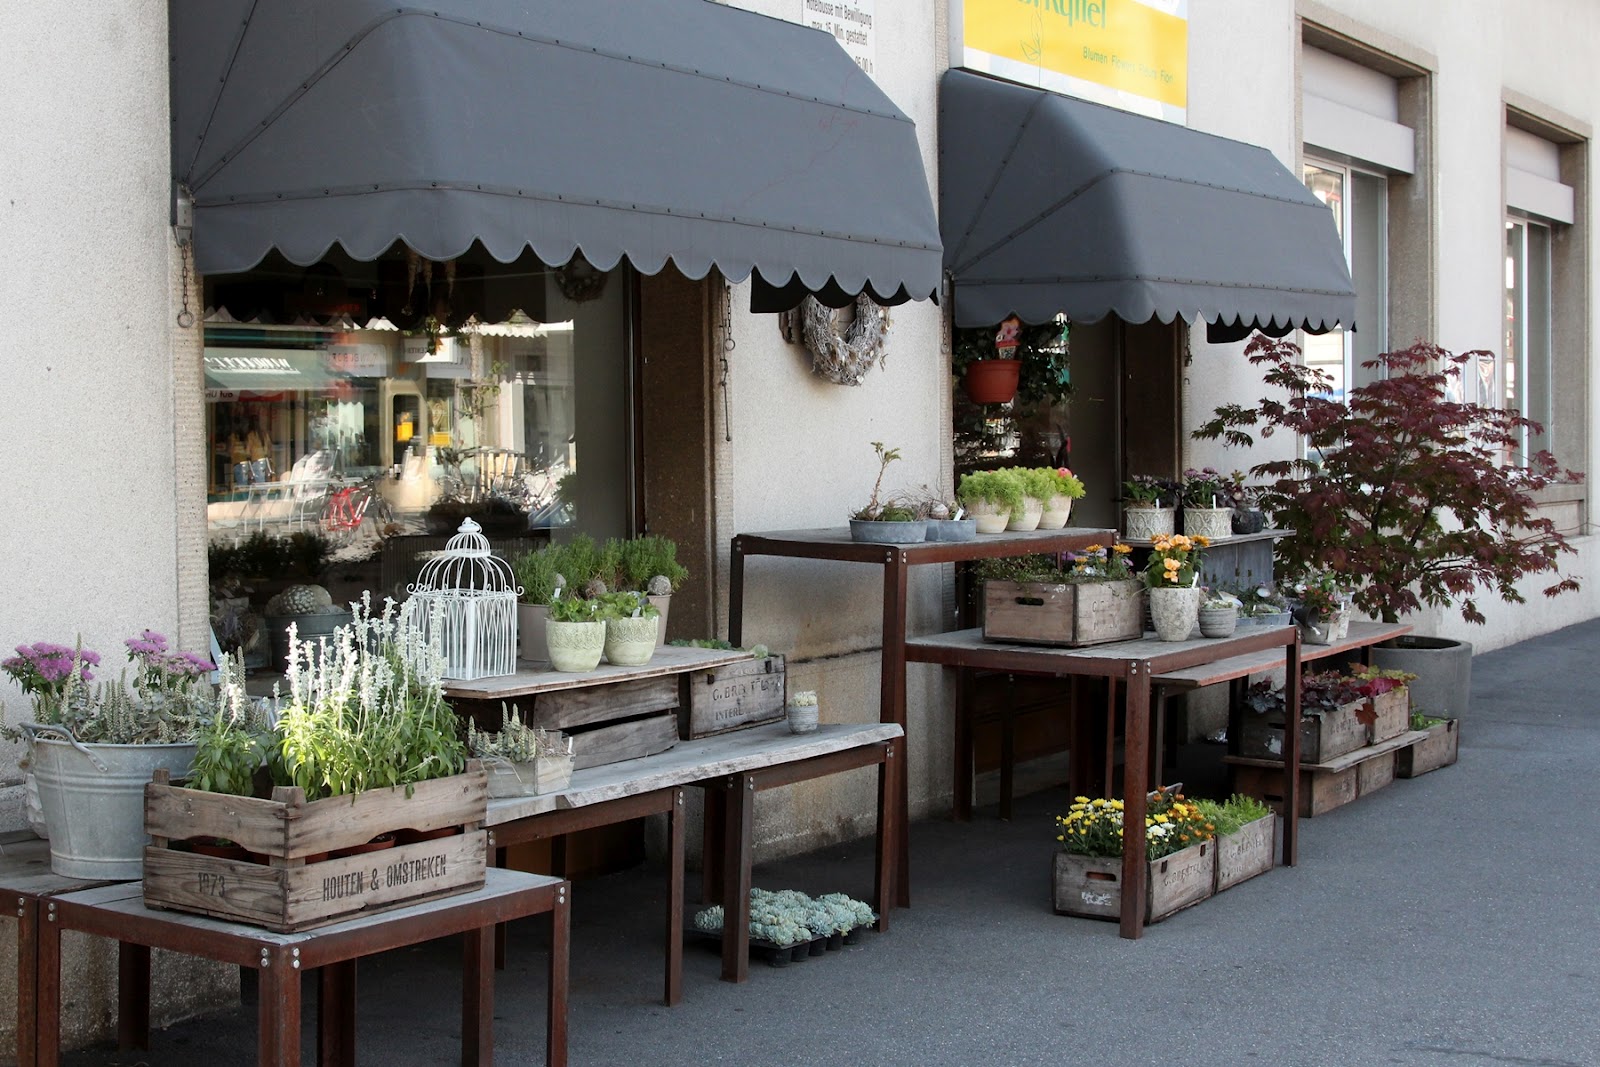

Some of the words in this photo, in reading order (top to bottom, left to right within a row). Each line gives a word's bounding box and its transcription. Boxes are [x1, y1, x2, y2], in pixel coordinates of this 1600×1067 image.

[835, 3, 844, 18] mit
[844, 4, 872, 29] Bewilligung
[846, 28, 868, 46] gestattet
[1083, 45, 1108, 64] Blumen
[323, 871, 363, 901] HOUTEN
[370, 868, 379, 890] &
[386, 854, 447, 887] OMSTREKEN
